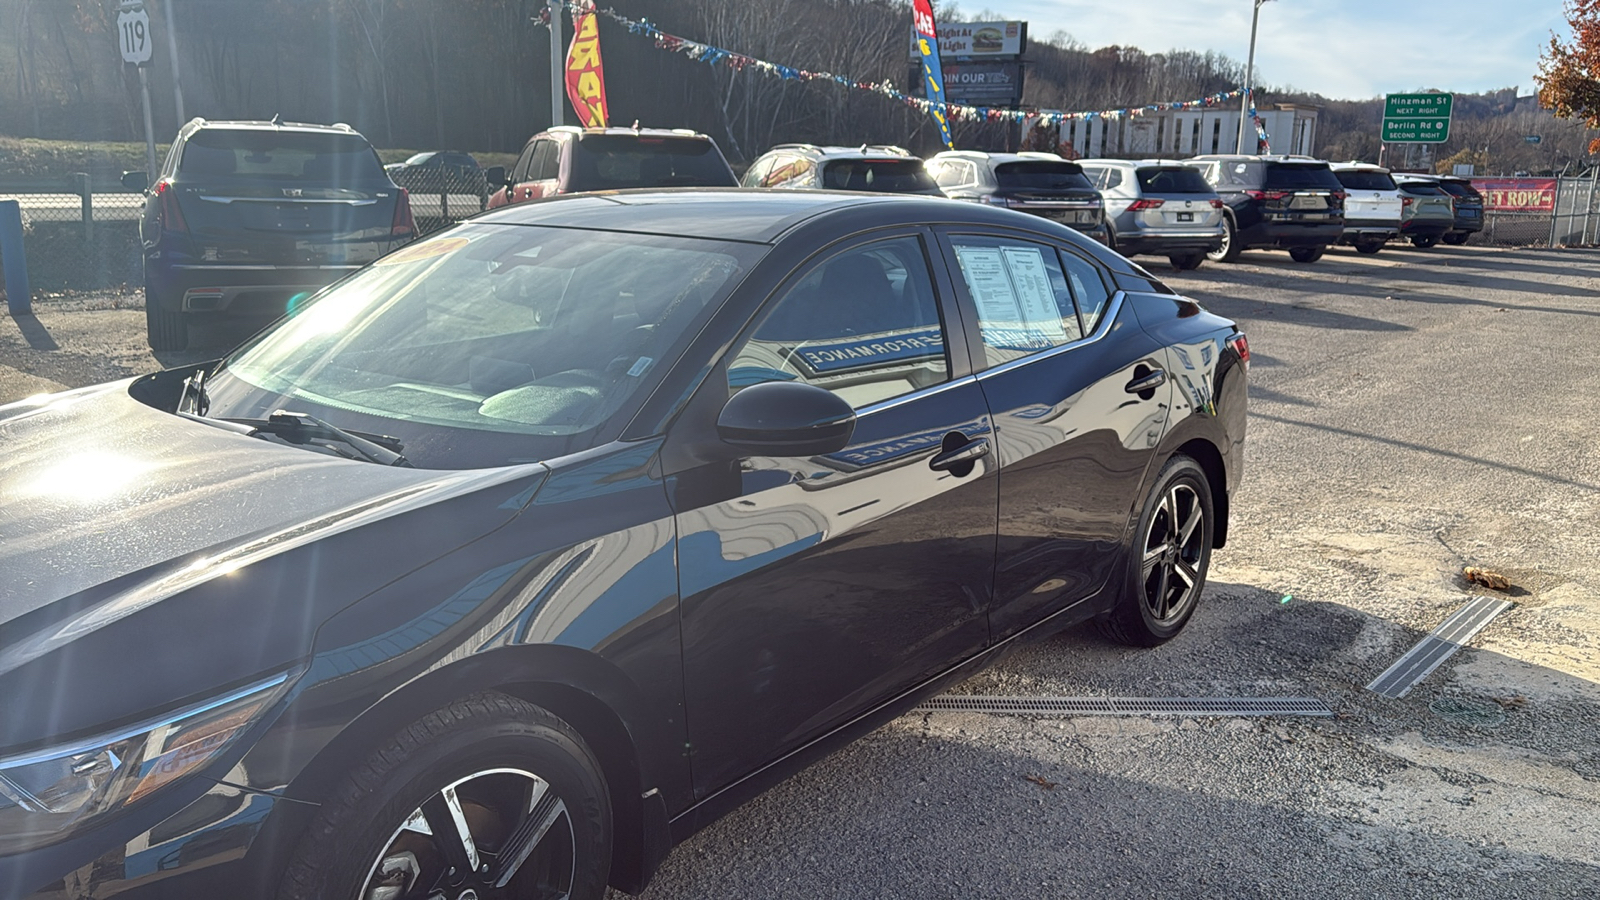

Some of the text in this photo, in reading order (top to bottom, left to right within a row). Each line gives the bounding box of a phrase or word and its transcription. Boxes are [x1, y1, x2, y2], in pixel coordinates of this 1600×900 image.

[123, 20, 145, 53] 119
[943, 41, 966, 52] Light
[961, 73, 985, 83] OUR
[1390, 96, 1447, 105] Hinzman St
[1396, 107, 1438, 115] NEXT RIGHT
[1387, 121, 1416, 130] Berlin
[1419, 121, 1432, 130] Rd
[1507, 190, 1543, 206] ROW
